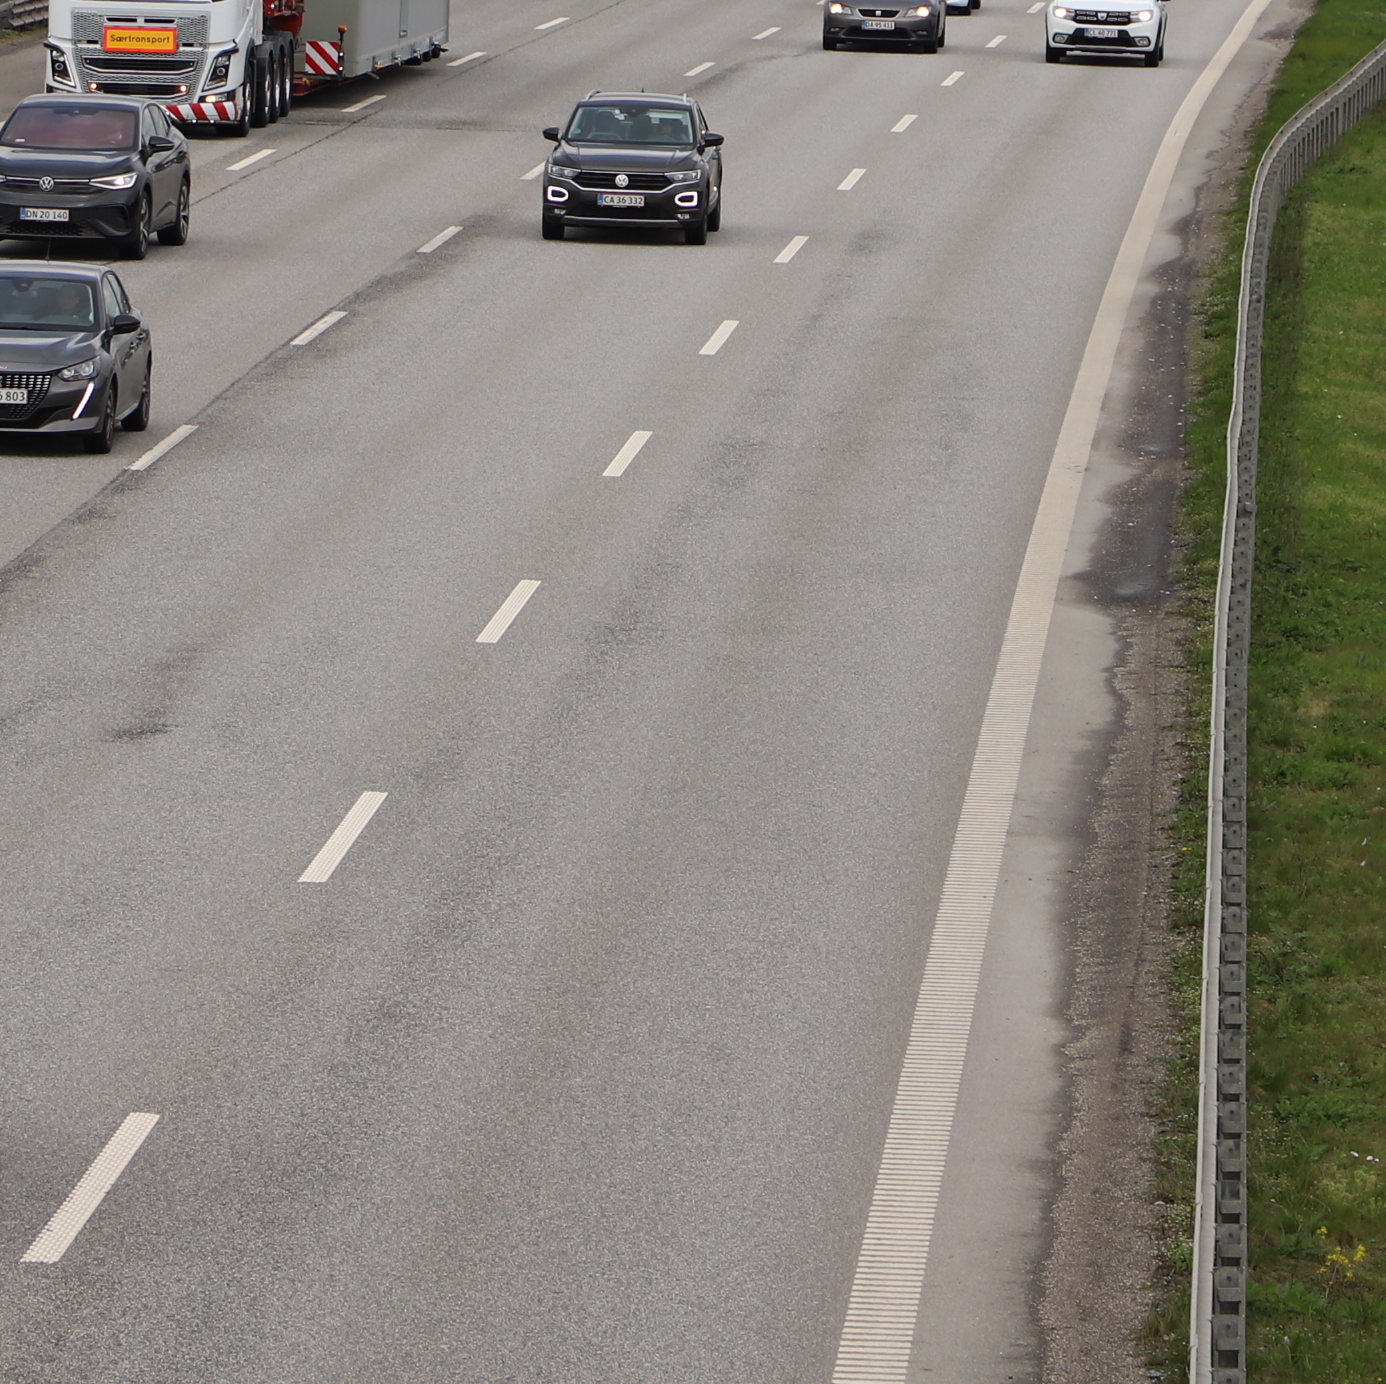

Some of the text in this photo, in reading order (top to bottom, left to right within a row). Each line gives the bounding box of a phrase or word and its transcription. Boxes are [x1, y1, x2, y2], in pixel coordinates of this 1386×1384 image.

[110, 34, 170, 45] Særtransport
[603, 195, 643, 205] CA 36 332
[27, 210, 68, 220] DN 20 140
[5, 391, 25, 402] 803
